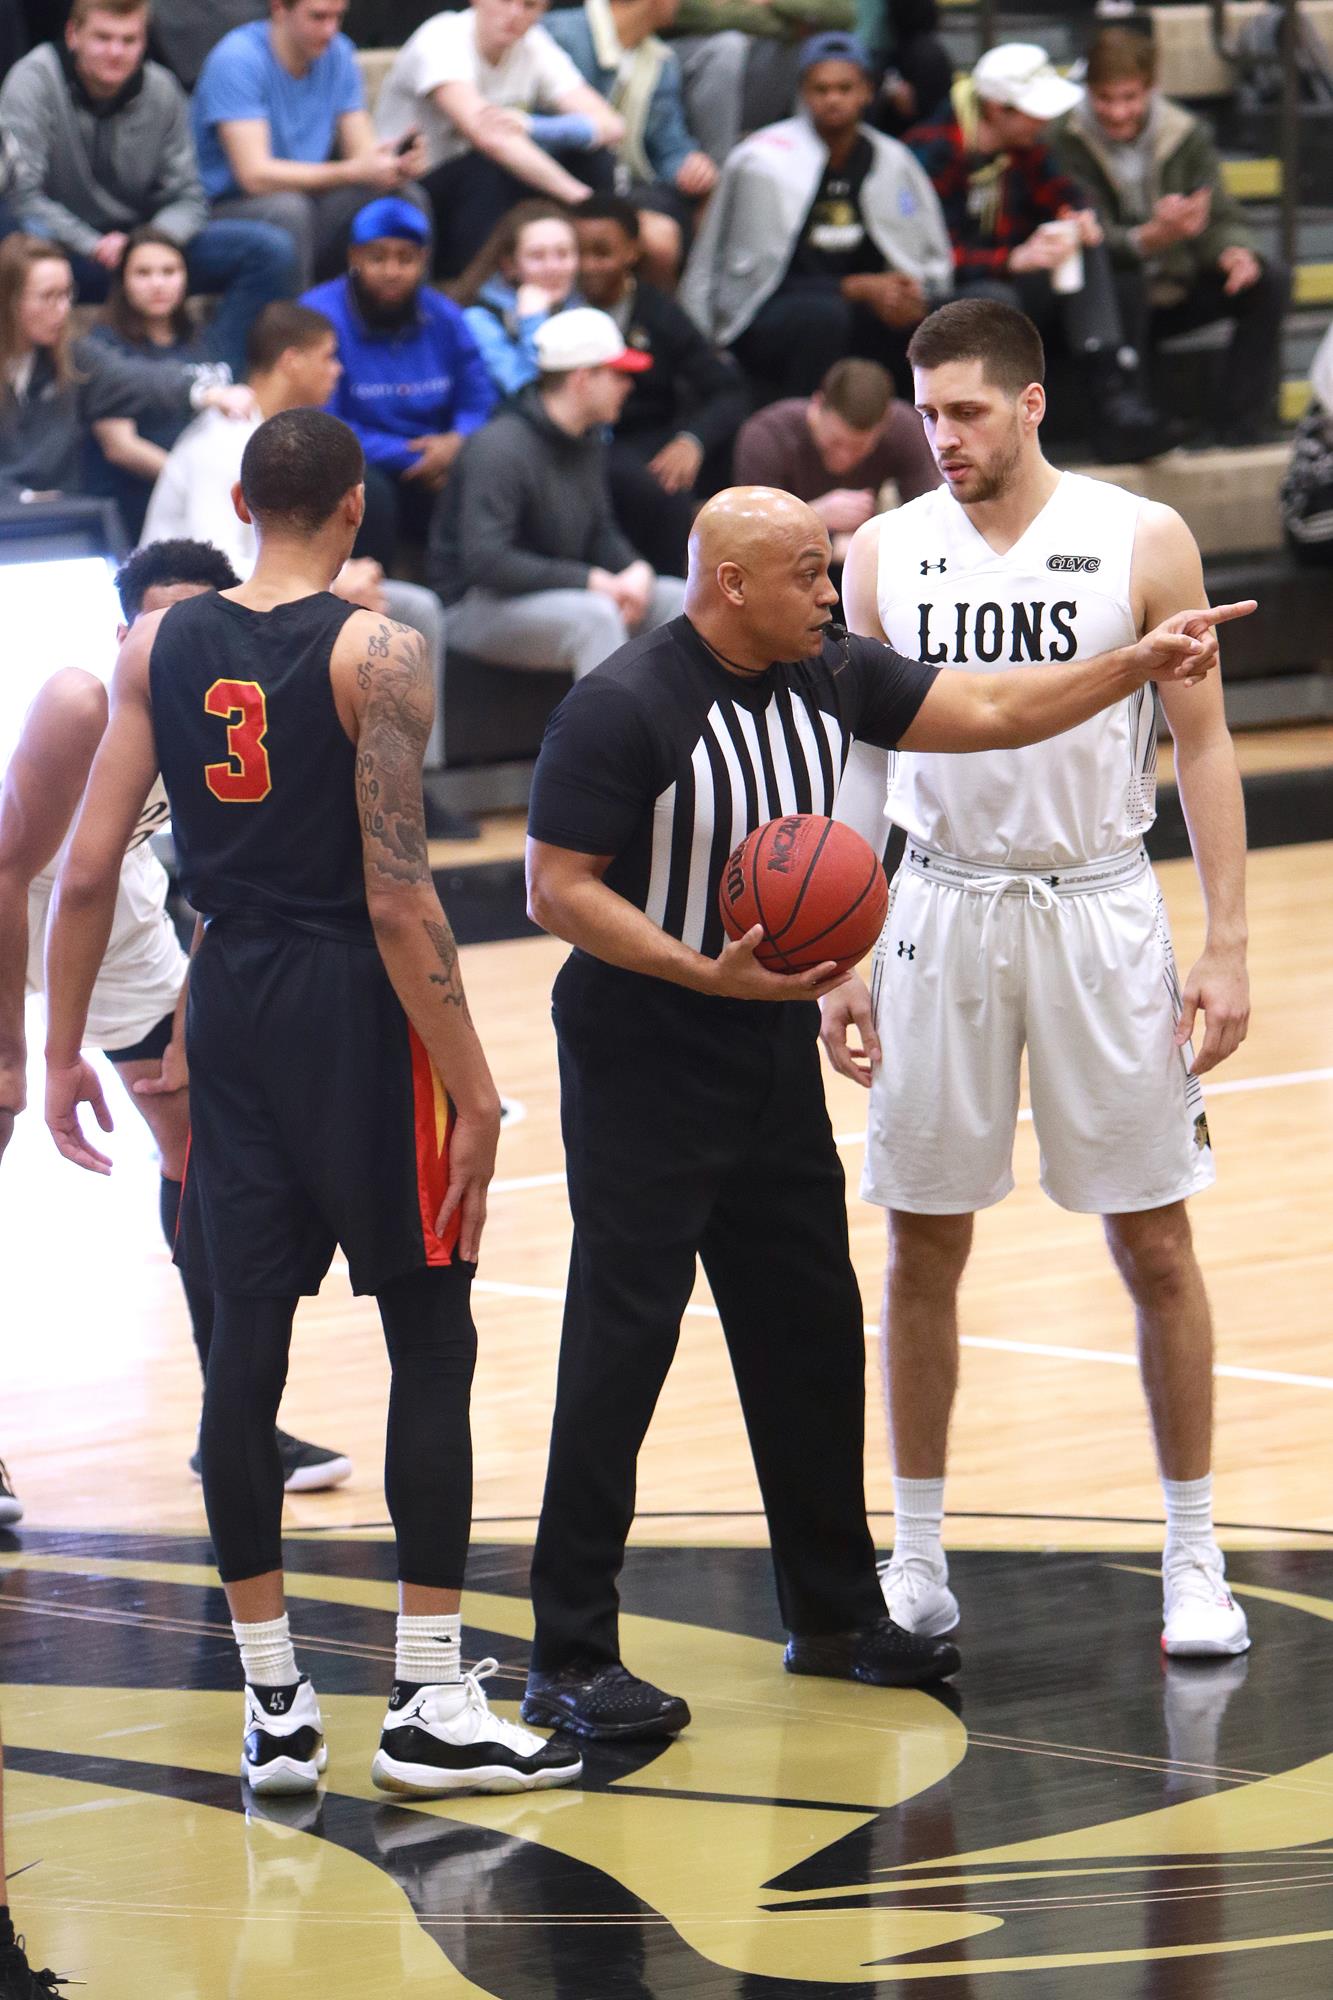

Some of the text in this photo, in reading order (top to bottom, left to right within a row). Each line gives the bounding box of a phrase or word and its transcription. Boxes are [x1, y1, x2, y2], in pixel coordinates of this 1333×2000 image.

[1046, 555, 1101, 573] GLVC
[918, 600, 1078, 664] LIONS
[204, 678, 272, 803] 3
[269, 1692, 285, 1711] 45
